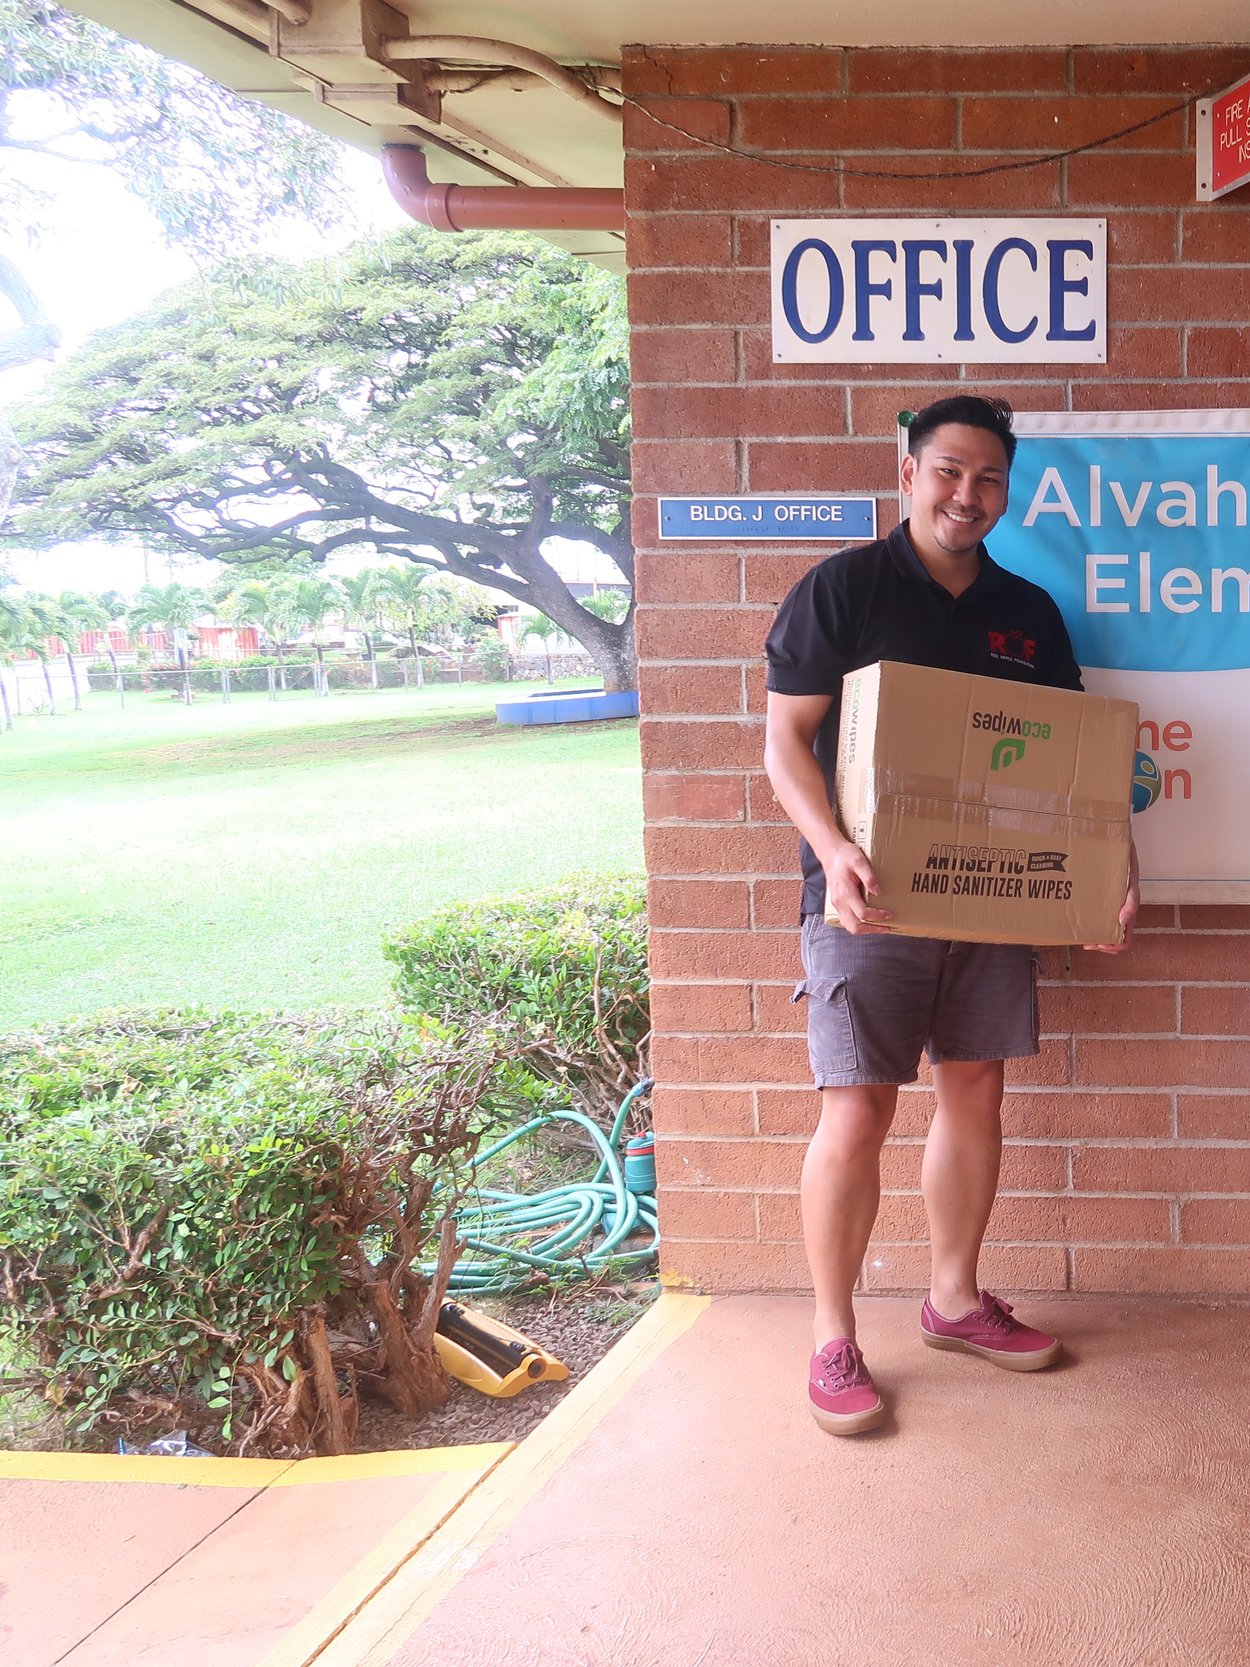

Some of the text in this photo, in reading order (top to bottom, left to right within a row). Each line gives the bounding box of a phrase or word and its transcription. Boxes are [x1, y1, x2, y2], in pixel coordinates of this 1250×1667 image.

[1225, 99, 1244, 126] FIRE
[1220, 125, 1243, 151] PULL
[781, 237, 1097, 343] OFFICE
[1022, 464, 1248, 528] Alvah
[690, 505, 843, 522] BLDG. J OFFICE
[848, 678, 862, 764] ecowipes
[972, 710, 1052, 740] ecowipes
[925, 843, 1026, 875] ANTISEPTIC
[911, 872, 1073, 900] HAND SANITIZER WIPES
